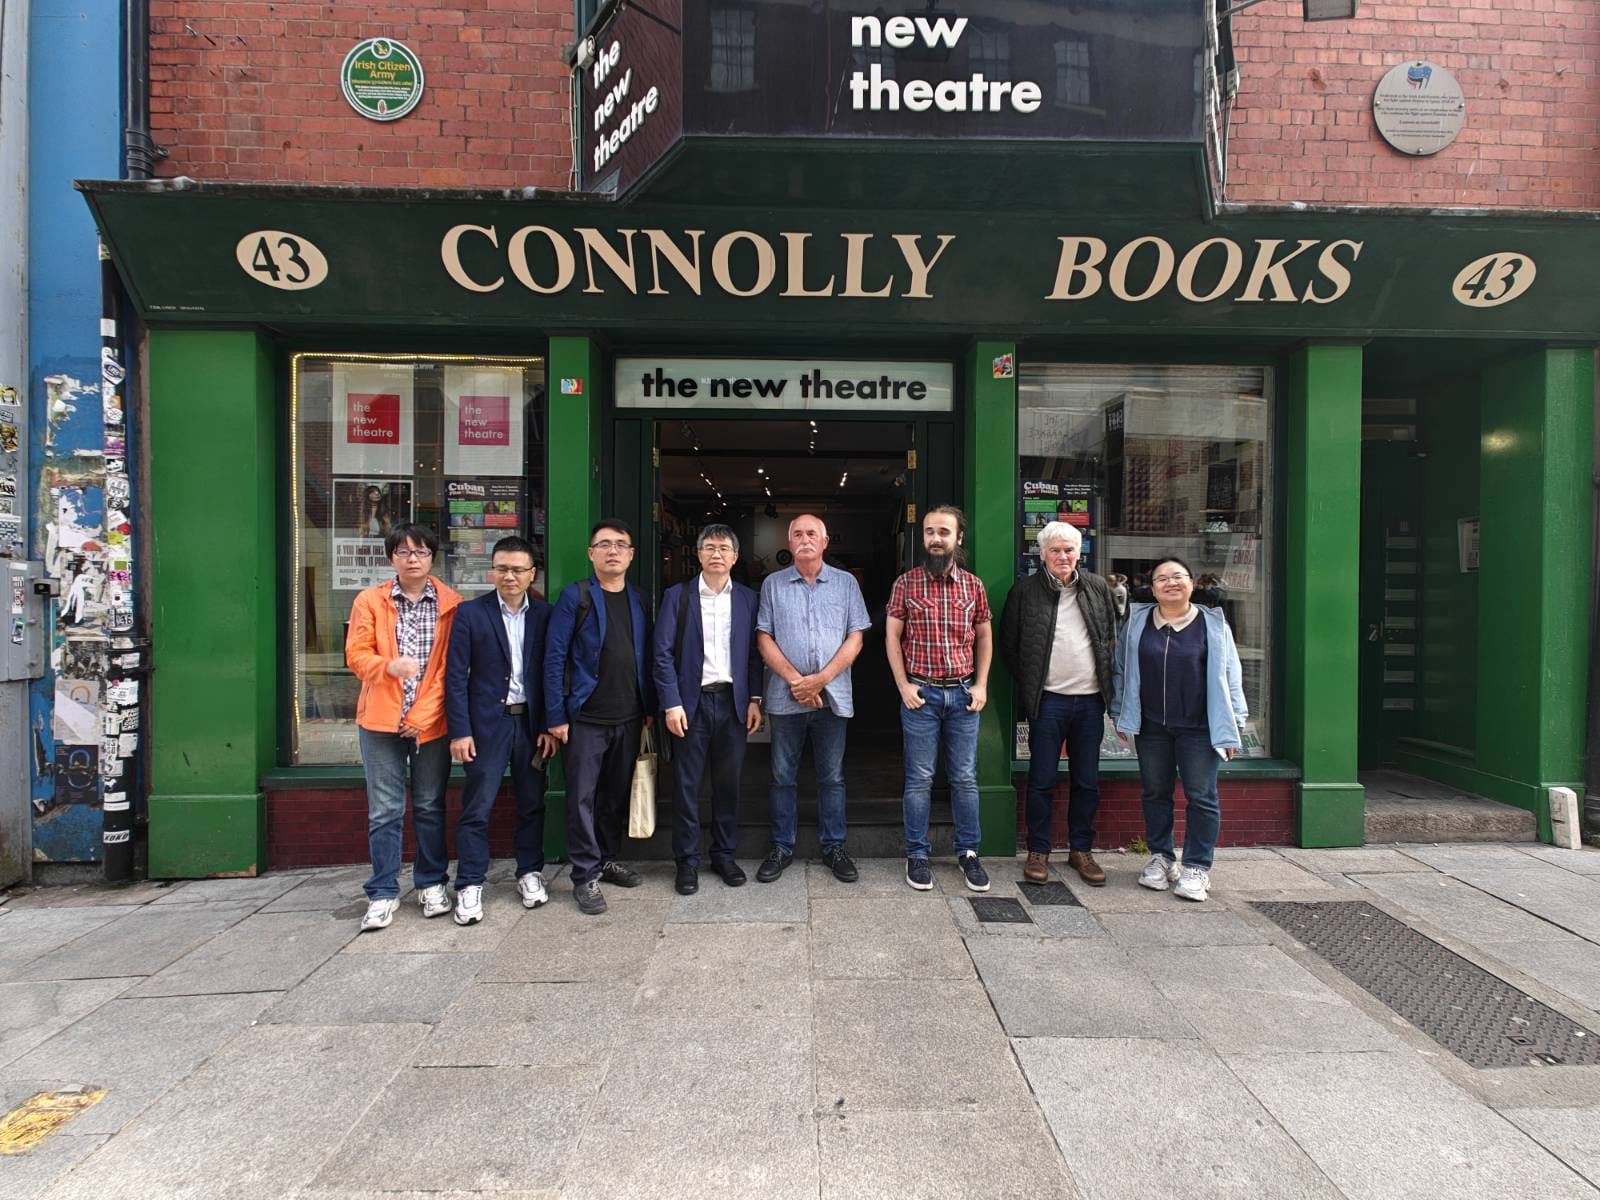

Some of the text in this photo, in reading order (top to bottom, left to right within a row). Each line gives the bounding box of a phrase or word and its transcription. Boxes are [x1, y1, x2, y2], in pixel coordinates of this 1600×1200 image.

[851, 16, 969, 48] new
[355, 60, 411, 72] Irish Citizen
[593, 40, 621, 89] the
[370, 70, 396, 80] Army
[849, 64, 1042, 112] theatre
[594, 68, 632, 131] new
[593, 85, 660, 173] theatre
[252, 236, 310, 284] 43
[441, 224, 1364, 304] CONNOLLY BOOKS
[1461, 257, 1523, 300] 43
[641, 368, 927, 401] the new theatre
[353, 401, 371, 413] the
[464, 403, 482, 415] the
[353, 416, 377, 425] new
[464, 417, 488, 427] new
[353, 425, 394, 438] theatre
[464, 428, 504, 440] theatre
[448, 482, 485, 492] Cuban
[1023, 481, 1059, 491] Cuban
